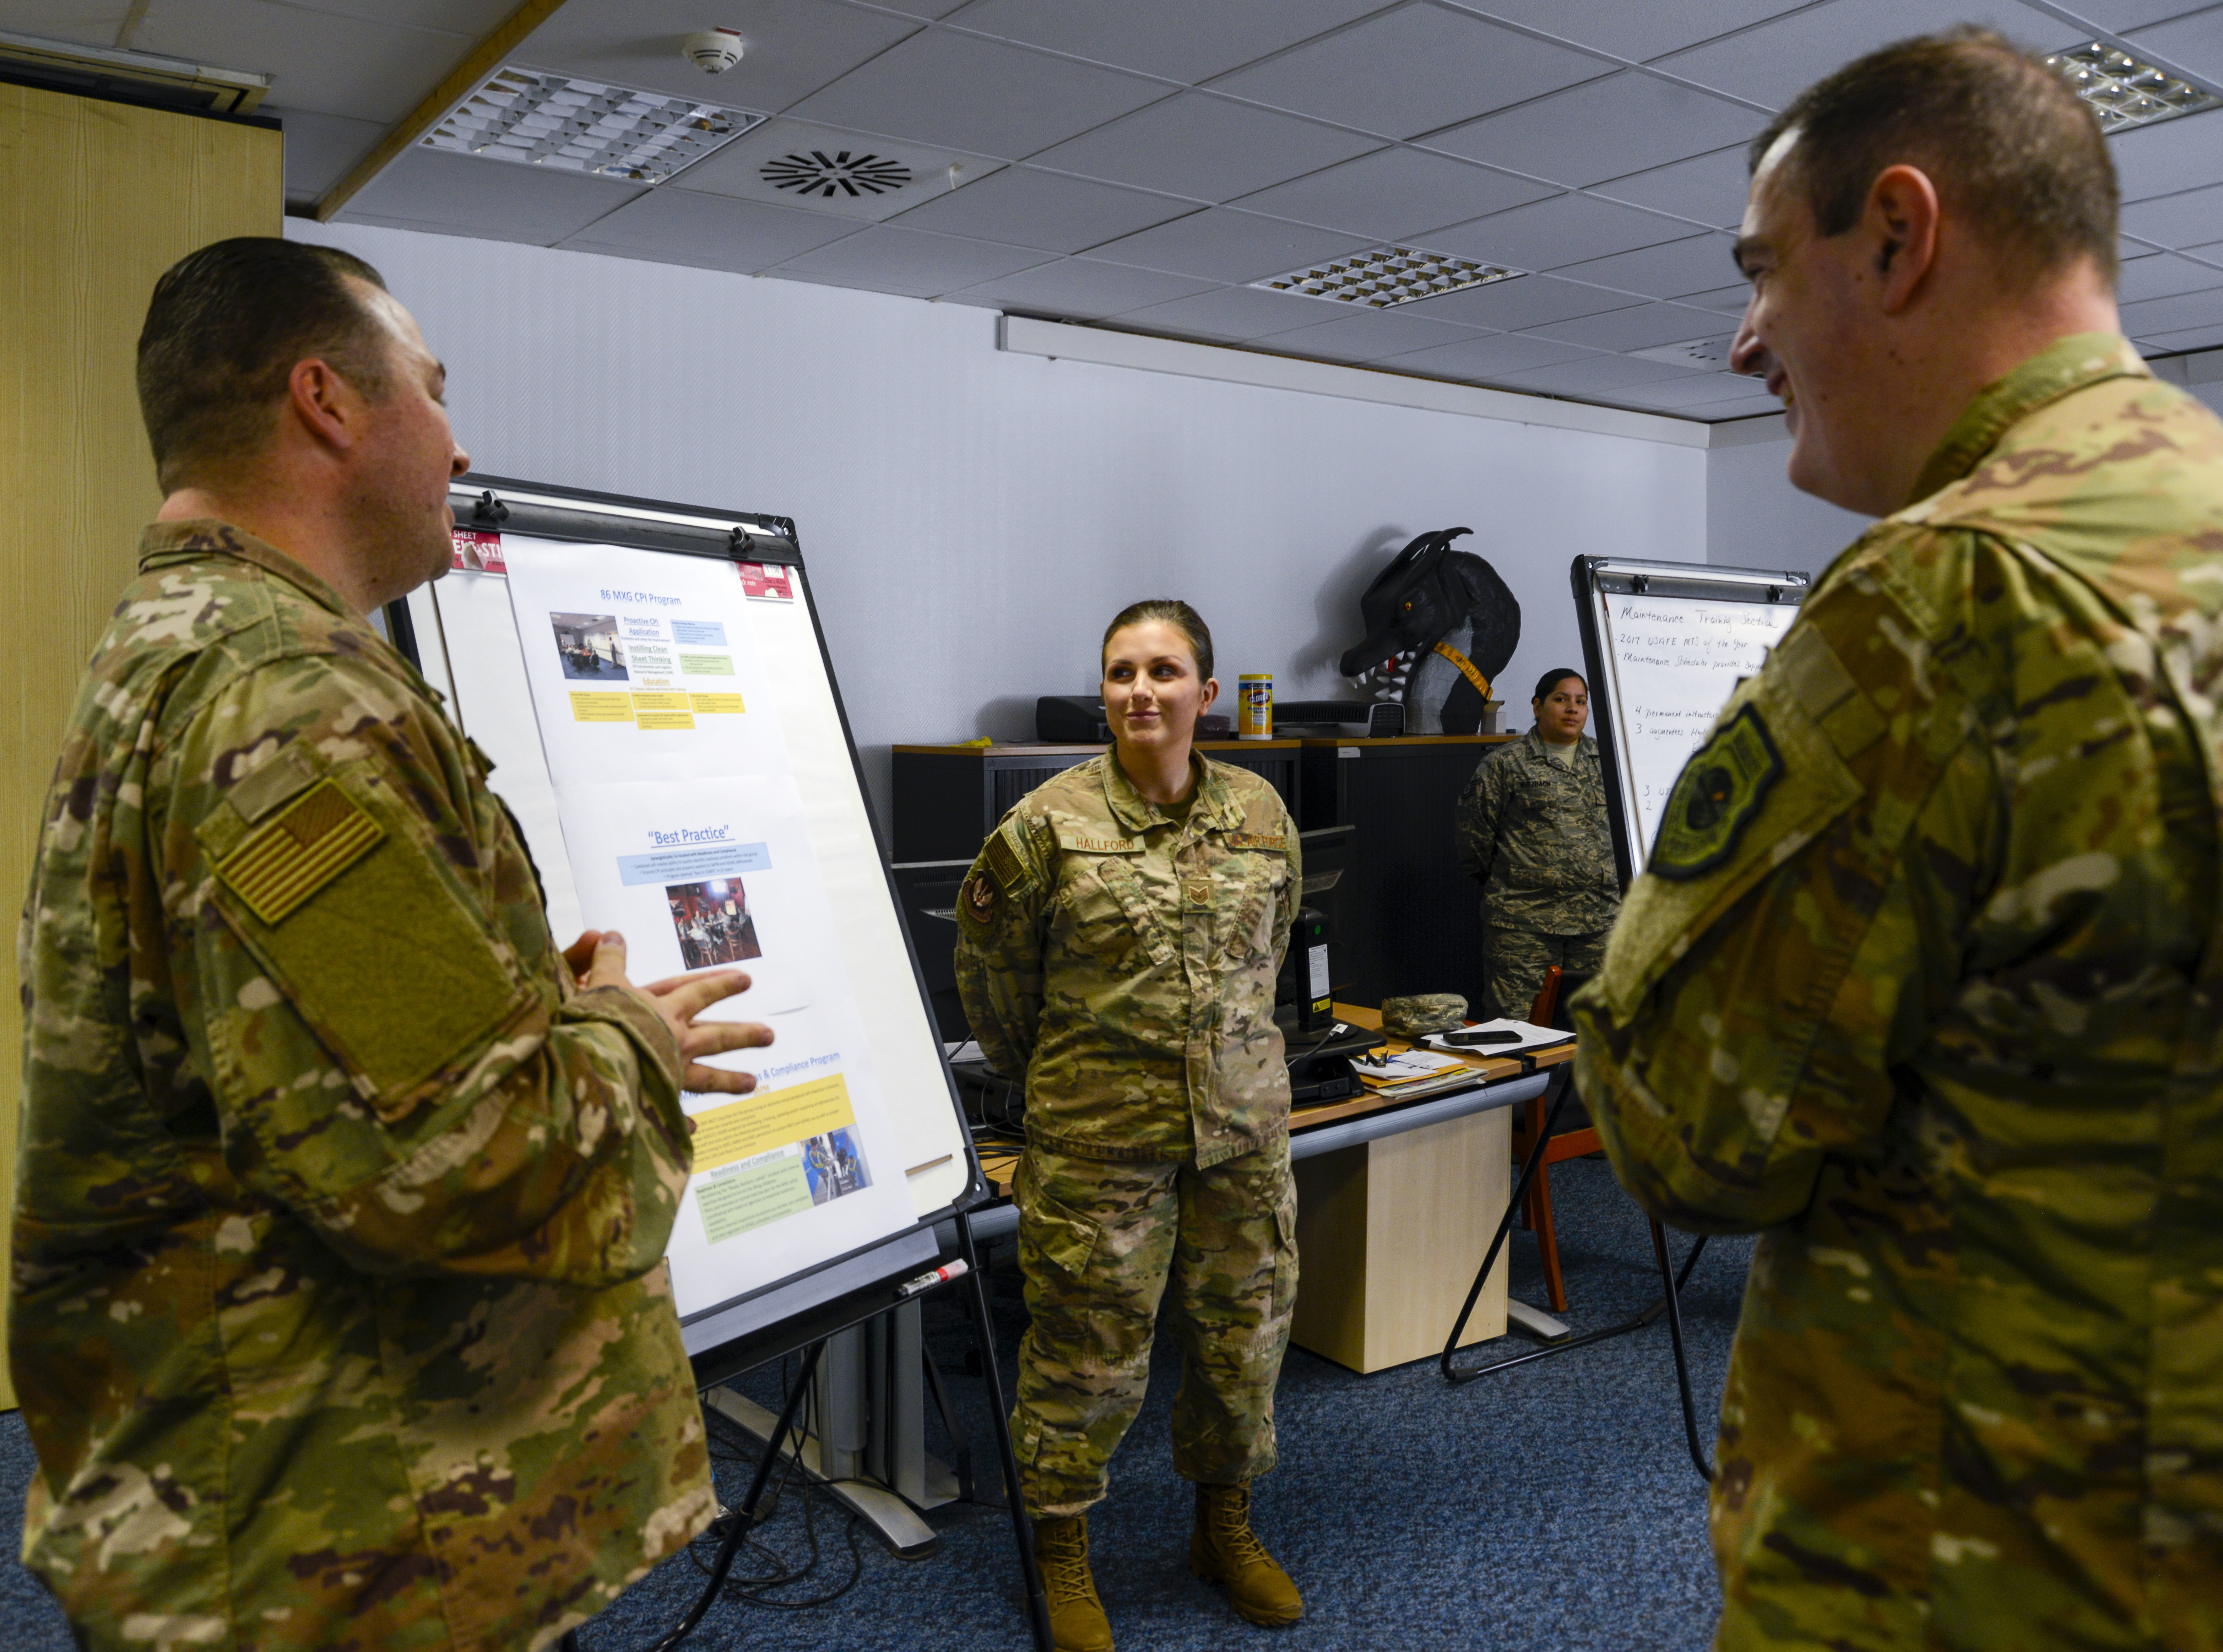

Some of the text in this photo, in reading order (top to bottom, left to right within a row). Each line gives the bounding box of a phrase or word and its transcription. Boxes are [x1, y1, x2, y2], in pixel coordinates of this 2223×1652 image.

[453, 530, 477, 540] SHEET
[601, 590, 682, 606] 86 MXG CPI Program
[624, 617, 649, 625] Proactive
[1621, 607, 1683, 623] Maintenance
[629, 628, 659, 636] Application
[629, 645, 652, 653] Instilling
[1620, 634, 1640, 644] 2017
[1648, 637, 1677, 646] USAFE
[1703, 639, 1713, 654] of
[1717, 638, 1728, 648] the
[1623, 653, 1670, 666] Maintenance
[1249, 693, 1270, 703] CLOROX
[1636, 706, 1642, 714] 4
[1645, 709, 1682, 718] permanent
[1635, 723, 1642, 734] 3
[1643, 785, 1650, 796] 3
[1646, 800, 1652, 810] 2
[1076, 837, 1134, 851] HALLFORD
[1229, 835, 1286, 849] U.S. AIR FORCE
[763, 1071, 770, 1079] &
[771, 1061, 809, 1077] Compliance
[810, 1052, 840, 1066] Program
[711, 1150, 784, 1177] Readiness and Compliance
